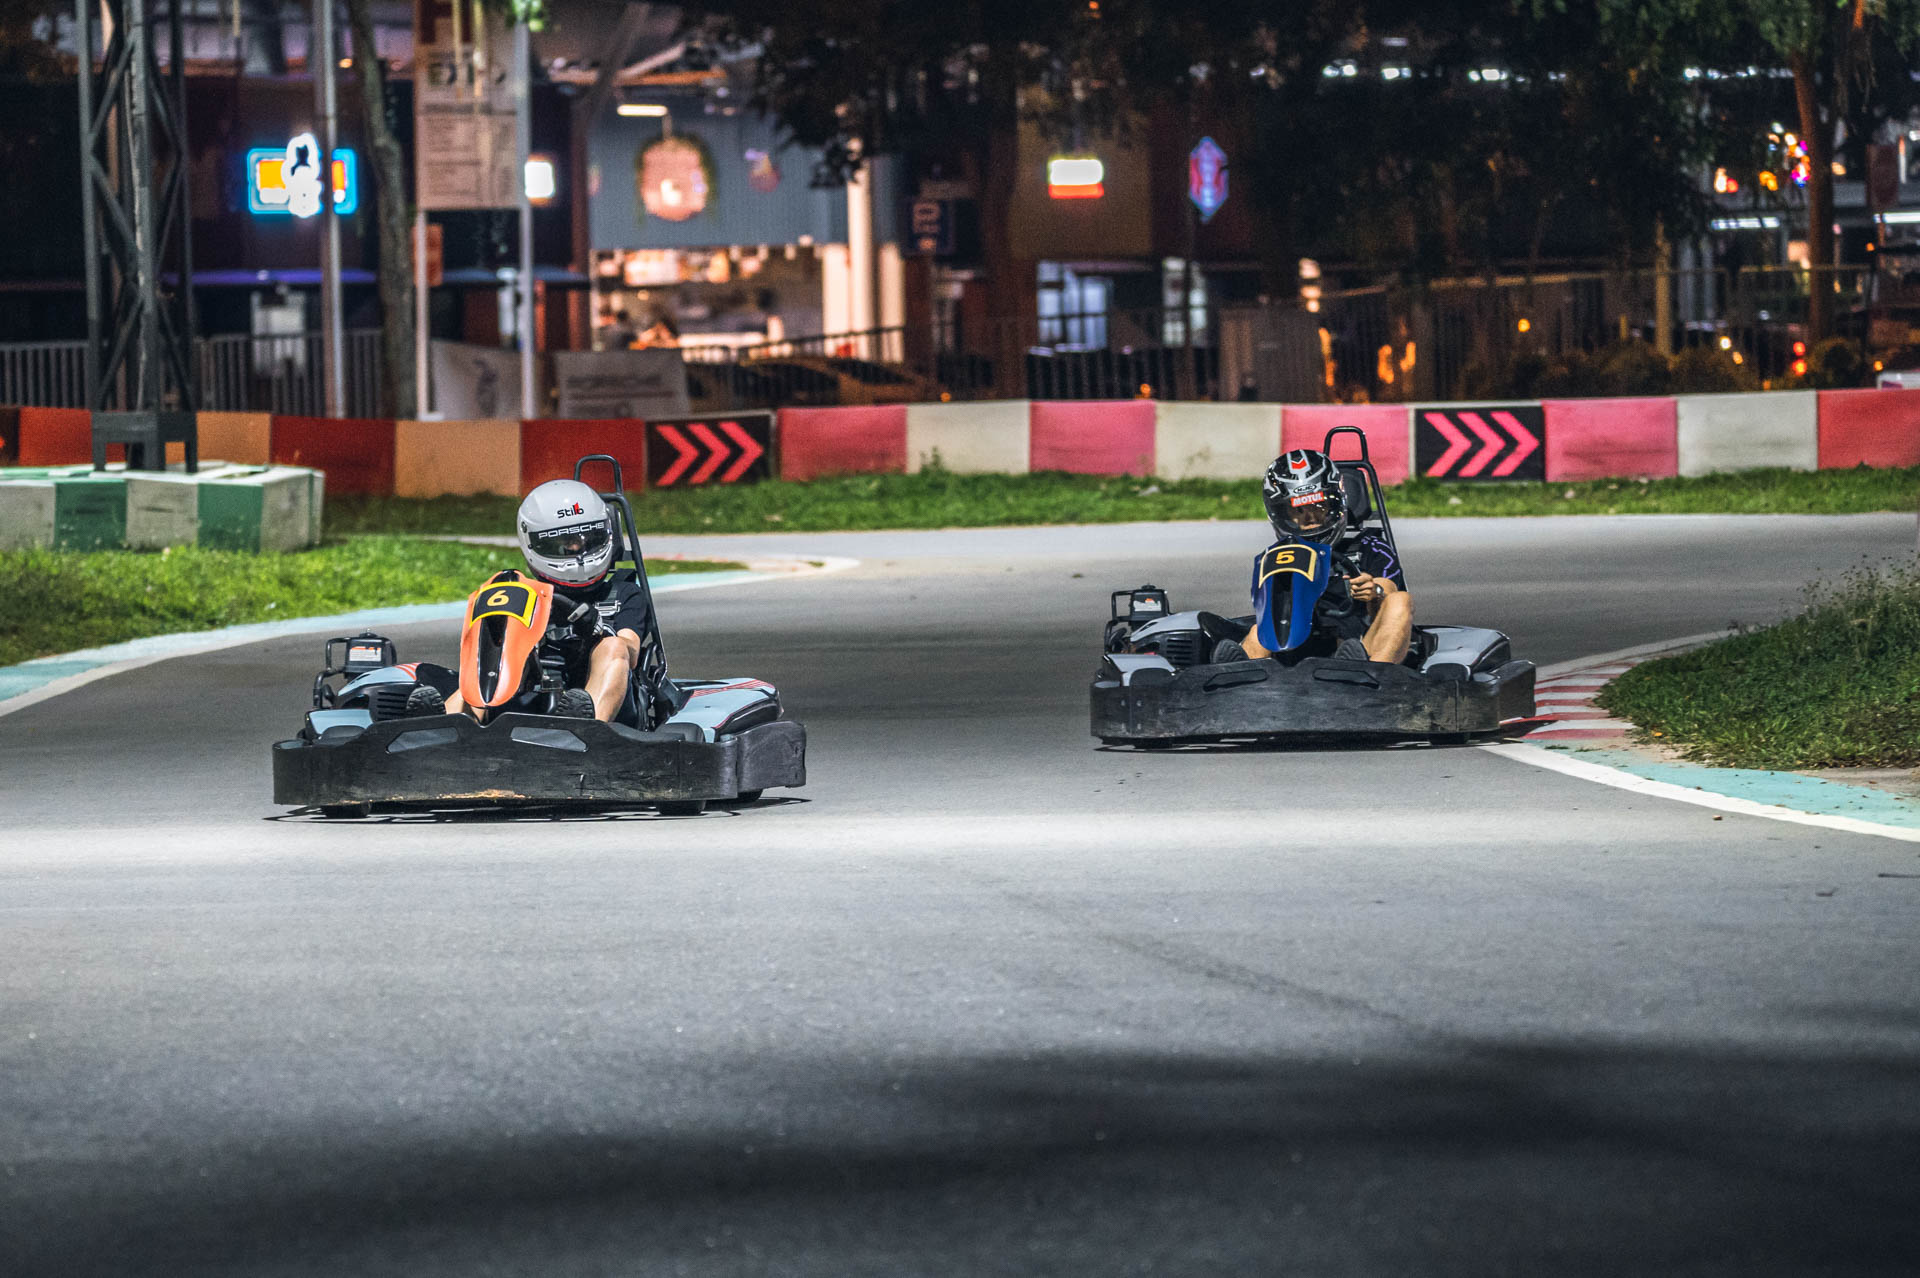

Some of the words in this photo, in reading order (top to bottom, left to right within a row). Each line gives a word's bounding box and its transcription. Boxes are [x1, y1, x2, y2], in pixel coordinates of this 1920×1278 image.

[1293, 492, 1323, 506] MOTUL
[557, 502, 584, 518] Stilo
[538, 522, 605, 539] PORSCHE
[1275, 550, 1295, 564] 5
[486, 589, 510, 607] 6
